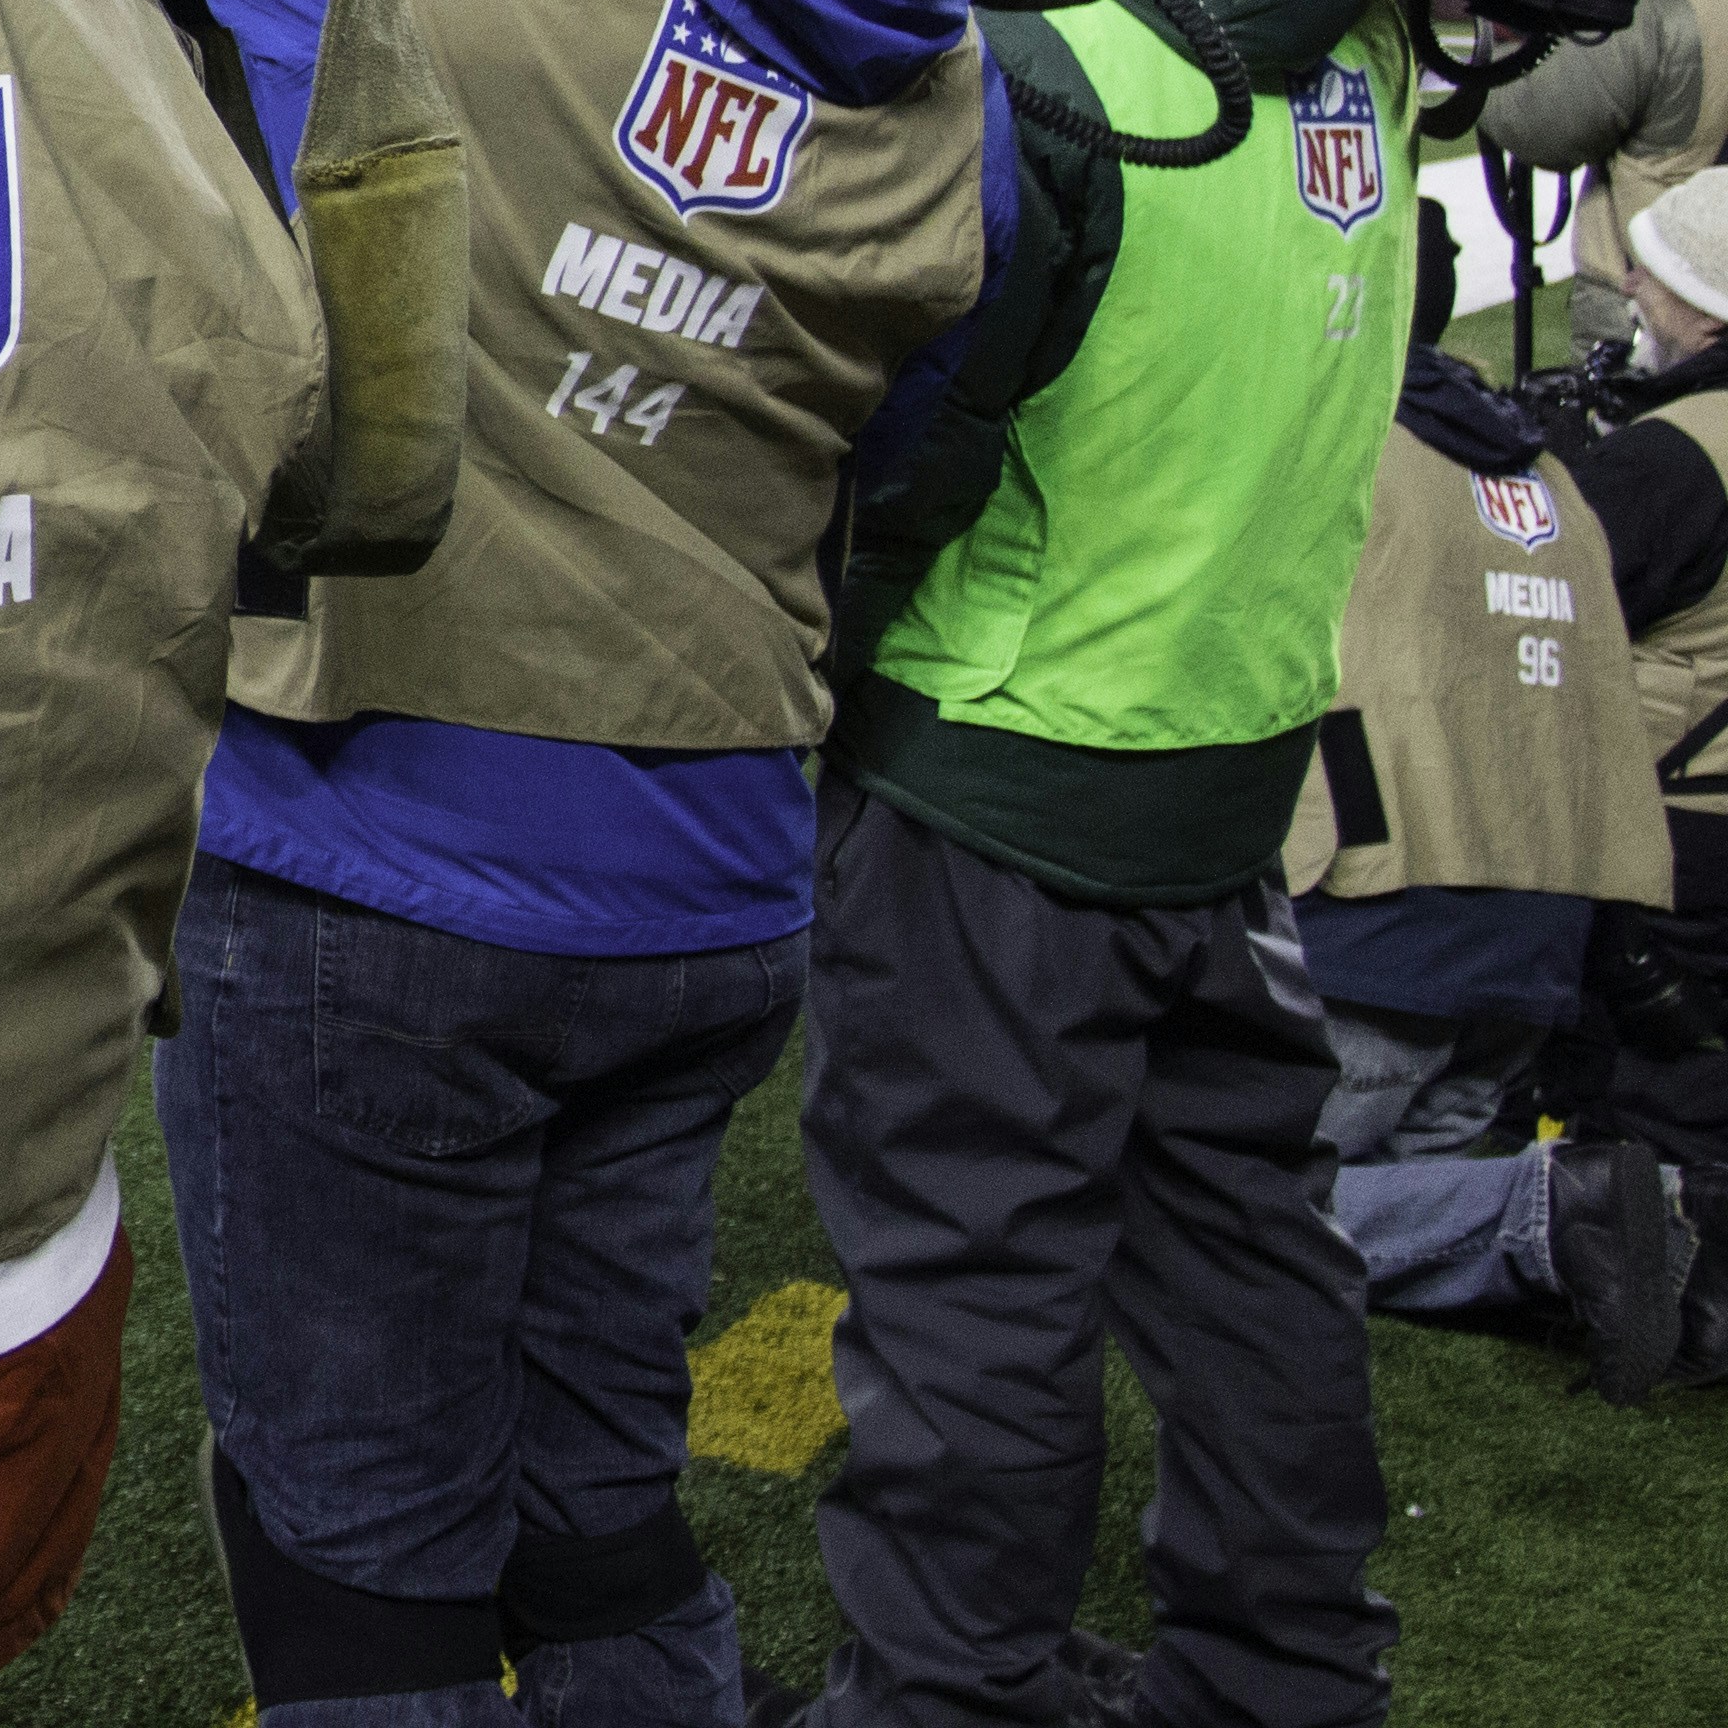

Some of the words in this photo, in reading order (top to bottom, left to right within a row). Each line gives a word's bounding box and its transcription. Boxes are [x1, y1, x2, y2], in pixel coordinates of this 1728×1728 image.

[635, 59, 780, 191] NFL
[1301, 126, 1376, 215] NFL
[541, 222, 766, 349] MEDIA
[545, 350, 688, 447] 144
[1476, 474, 1551, 535] NFL
[1486, 570, 1575, 622] MEDIA
[1517, 634, 1561, 688] 96
